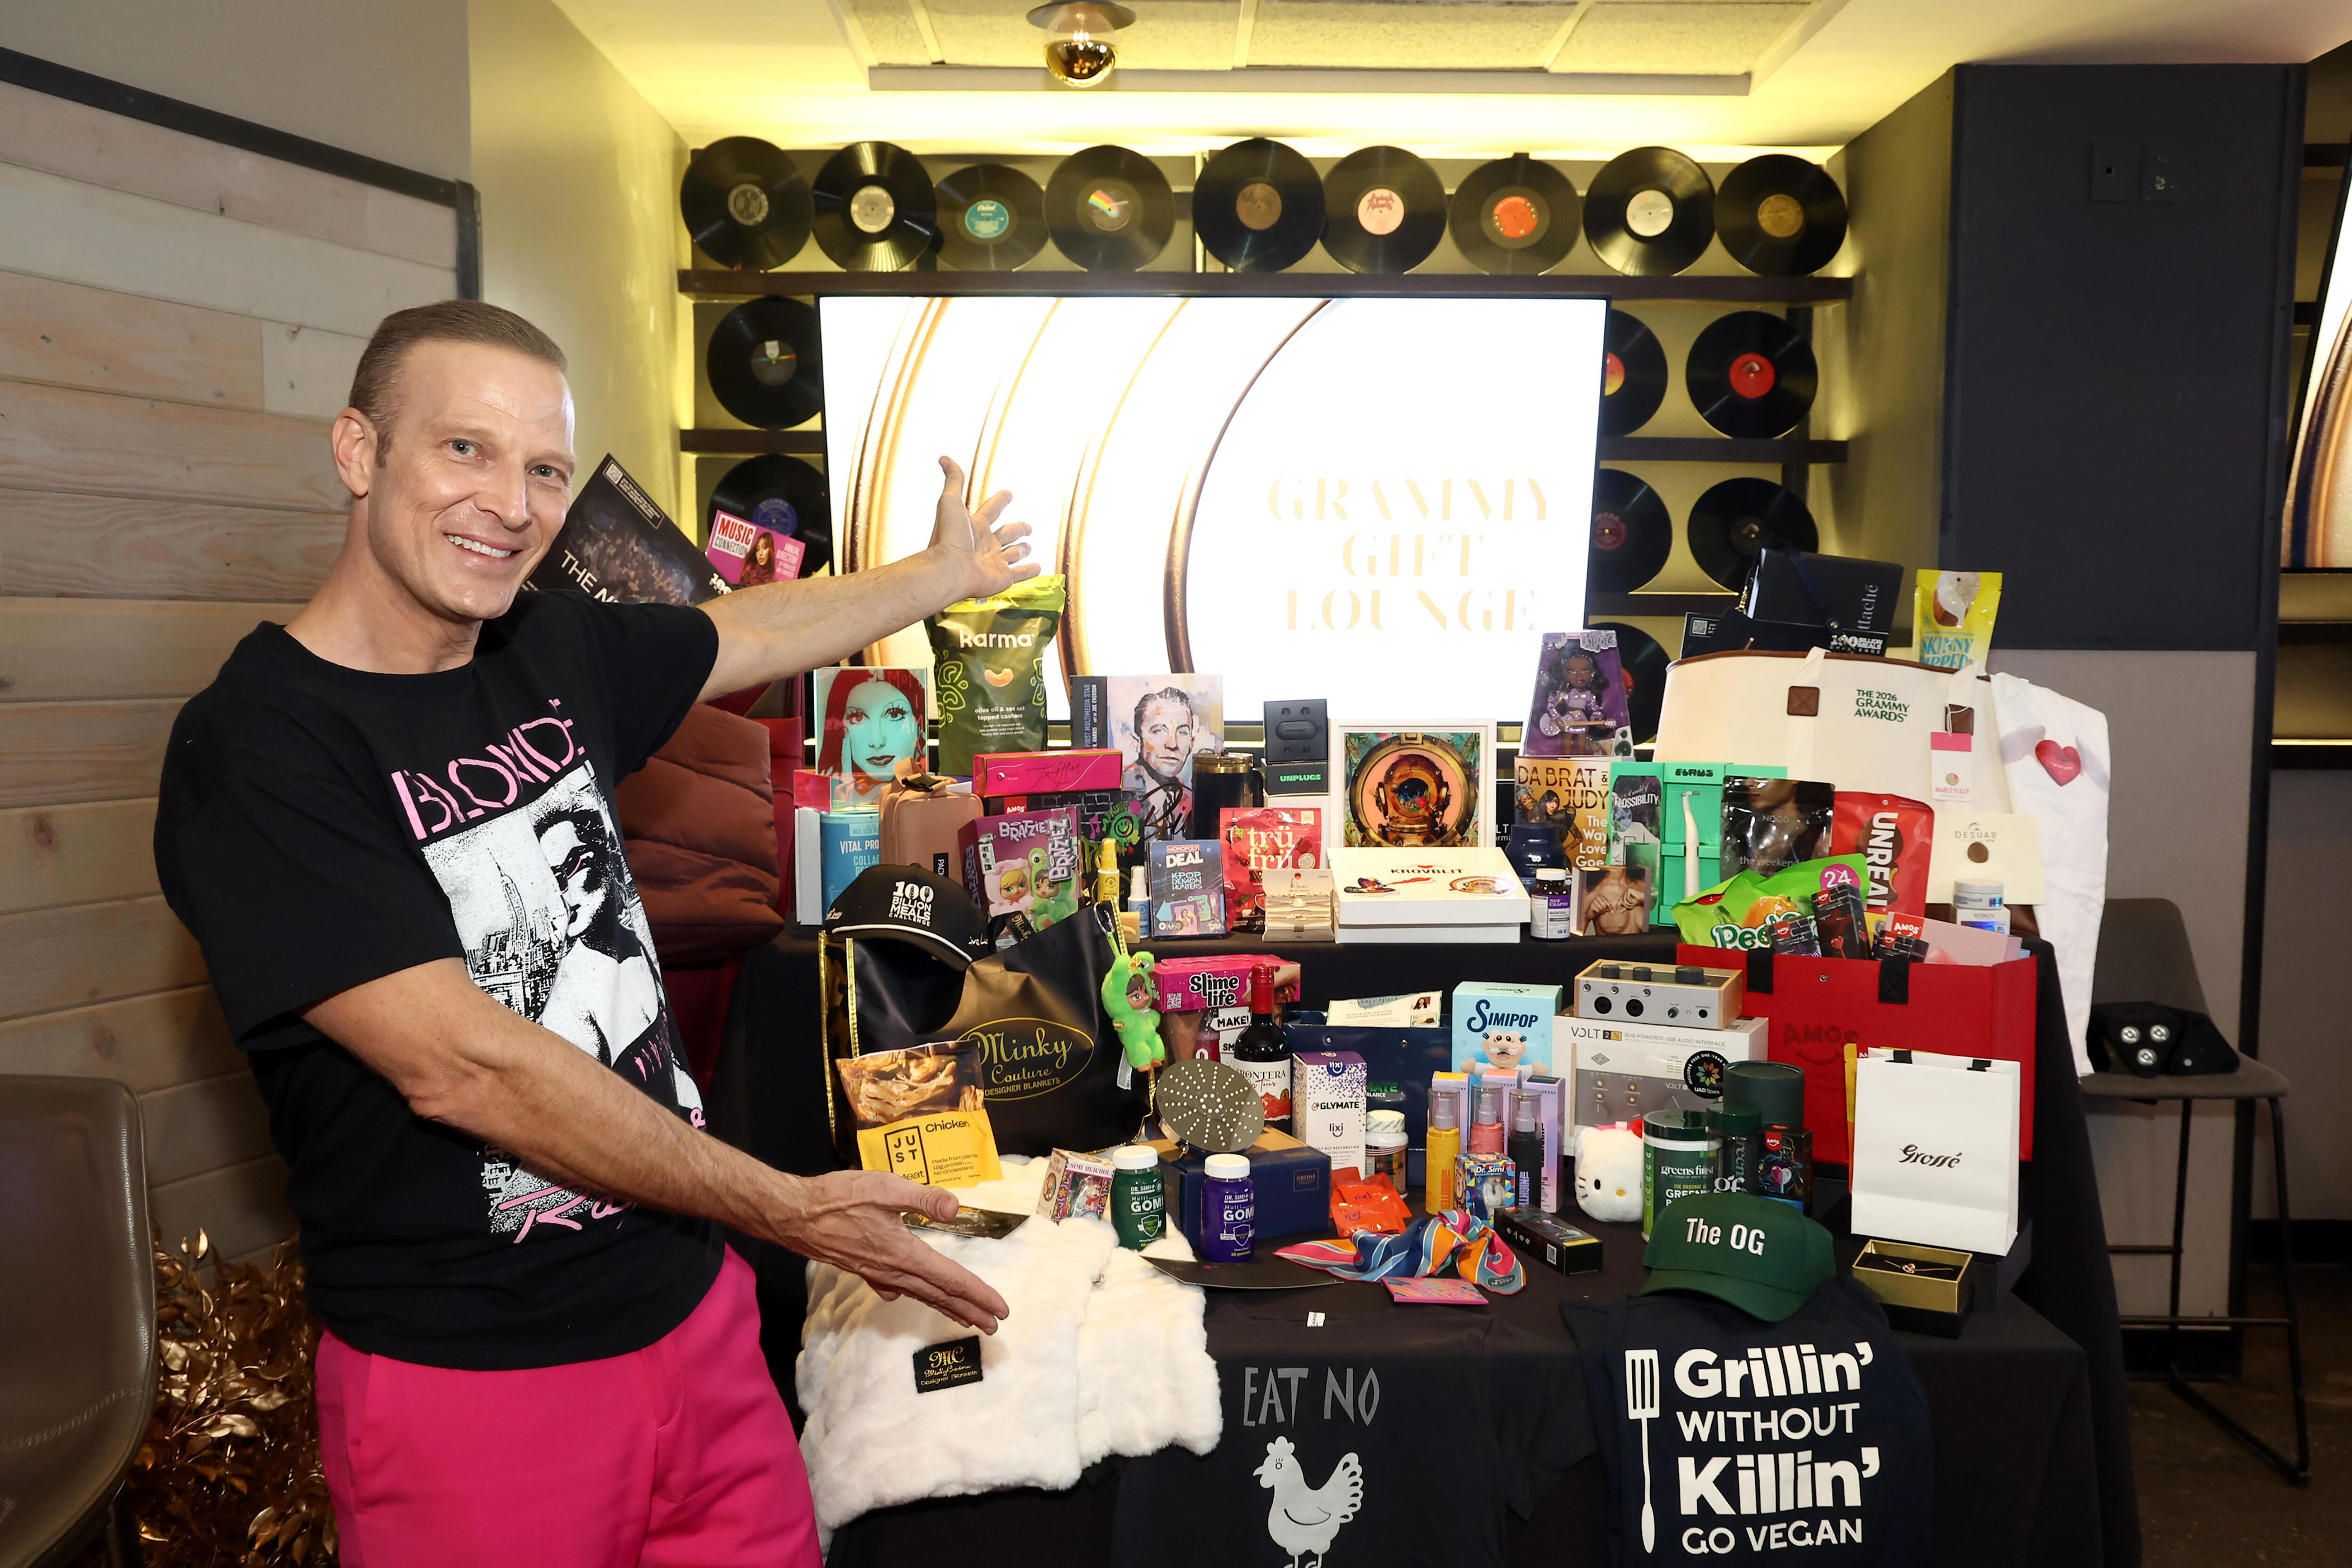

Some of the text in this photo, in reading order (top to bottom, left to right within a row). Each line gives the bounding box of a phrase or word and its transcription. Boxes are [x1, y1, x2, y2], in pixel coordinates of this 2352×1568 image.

[1268, 478, 1546, 520] GRAMMY
[718, 518, 753, 545] MUSIC
[715, 536, 748, 555] CONNECTION
[1343, 534, 1484, 575] GIFT
[561, 550, 597, 593] THE
[1287, 589, 1534, 631] LOUNGE
[959, 629, 1033, 648] karma
[1857, 689, 1897, 701] THE 2026
[1856, 697, 1910, 713] GRAMMY
[1854, 708, 1905, 722] AWARDS
[901, 715, 923, 734] AM
[1280, 773, 1321, 782] UNPLUGS
[1518, 766, 1541, 785] DA
[1546, 768, 1597, 787] BRAT
[1563, 789, 1609, 809] JUDY
[1614, 793, 1659, 809] FLOSSIBILITY
[1007, 806, 1025, 814] AMOS
[1586, 815, 1607, 828] The
[1763, 815, 1789, 823] NOOD
[1248, 825, 1294, 848] trü
[1583, 829, 1607, 843] Way
[840, 840, 862, 854] VITAL
[1579, 843, 1607, 855] Love
[1165, 851, 1203, 868] DEAL
[1740, 856, 1755, 865] the
[1865, 811, 1898, 908] UNREAL
[1172, 877, 1202, 885] DEMON
[1172, 882, 1202, 891] HUNTERS
[1824, 870, 1852, 888] 24
[892, 881, 934, 903] 100
[890, 904, 931, 921] MEALS
[892, 896, 932, 912] BILLION
[889, 913, 931, 927] CHALLENGE
[1894, 922, 1919, 935] AMOS
[1189, 972, 1239, 998] Slime
[1217, 1015, 1249, 1028] MAKE!
[1467, 999, 1538, 1033] SIMIPOP
[1571, 1027, 1601, 1039] VOLT
[1624, 1032, 1664, 1041] BUS-POWERED
[972, 1027, 1073, 1073] Minky
[991, 1063, 1053, 1085] Couture
[985, 1076, 1061, 1096] DESIGNER BLANKETS
[1320, 1102, 1359, 1110] GLYMATE
[925, 1120, 970, 1132] Chicken
[1329, 1123, 1343, 1134] lixi
[1898, 1144, 1963, 1168] Grossé
[1085, 1166, 1110, 1175] HUICHOL
[1661, 1166, 1694, 1175] greens
[1687, 1218, 1767, 1256] The OG
[929, 1346, 965, 1368] MC
[920, 1376, 948, 1386] Designer
[1243, 1366, 1380, 1428] EAT NO
[1676, 1403, 1860, 1442] WITHOUT
[1682, 1518, 1862, 1555] GO VEGAN
